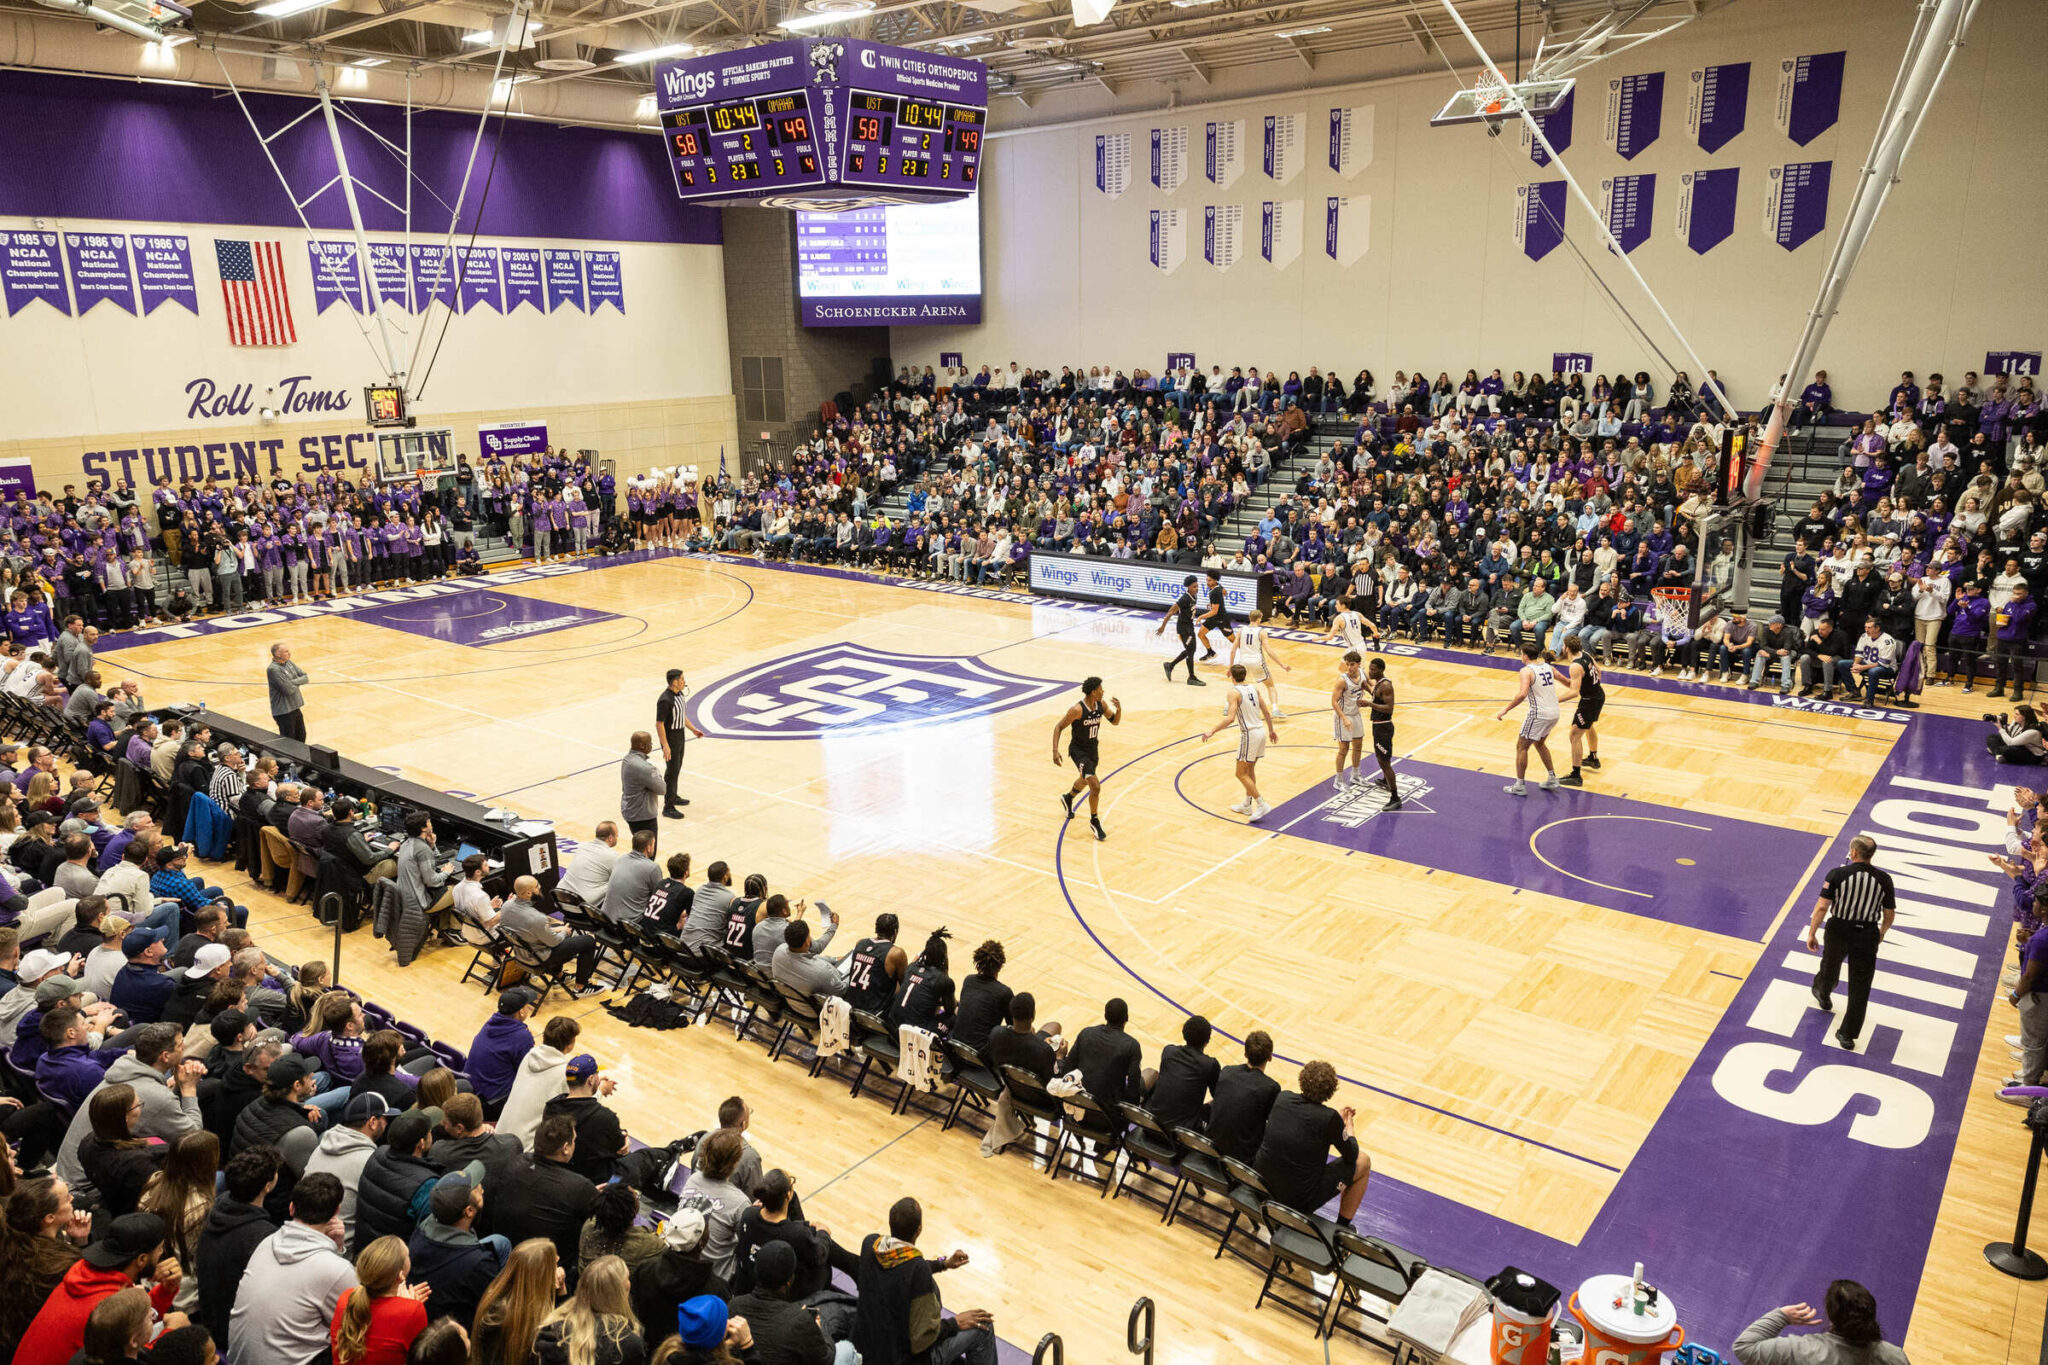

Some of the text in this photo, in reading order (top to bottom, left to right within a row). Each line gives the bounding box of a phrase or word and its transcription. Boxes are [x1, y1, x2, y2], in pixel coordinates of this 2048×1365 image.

[722, 65, 744, 76] OFFICIAL
[769, 56, 794, 70] PARTNER
[880, 55, 977, 82] TWIN CITIES ORTHOPEDICS
[664, 67, 715, 98] Wings
[723, 77, 730, 86] OF
[751, 71, 770, 82] SPORTS
[913, 77, 925, 86] Sports
[944, 82, 961, 91] Provider
[668, 93, 696, 103] Credit Union
[768, 97, 794, 113] OMAHA
[866, 97, 882, 110] UST
[676, 112, 690, 126] UST
[715, 106, 756, 129] 10:44
[906, 104, 941, 127] 10:44
[954, 109, 976, 122] OMAHA
[784, 118, 808, 140] 49
[823, 90, 838, 181] TOMMIES
[859, 118, 878, 140] 58
[676, 134, 697, 155] 58
[744, 134, 750, 150] 2
[922, 134, 930, 149] 2
[962, 132, 978, 150] 49
[776, 160, 783, 175] 3
[805, 158, 814, 170] 4
[855, 157, 862, 170] 4
[880, 158, 886, 173] 3
[903, 160, 916, 175] 23
[943, 164, 949, 178] 3
[685, 172, 693, 184] 4
[709, 168, 716, 182] 3
[732, 164, 747, 180] 23
[967, 167, 974, 179] 4
[12, 233, 40, 246] 1985
[83, 236, 109, 248] 1986
[148, 238, 173, 249] 1986
[9, 248, 48, 258] NCAA
[80, 250, 116, 260] NCAA
[146, 252, 180, 261] NCAA
[423, 248, 440, 256] 2001
[6, 270, 59, 278] Champions
[77, 271, 126, 279] Champions
[143, 272, 189, 280] Champions
[1176, 358, 1191, 369] 112
[1565, 359, 1586, 372] 113
[2002, 358, 2031, 375] 114
[185, 376, 352, 418] Roll Toms
[82, 439, 285, 491] STUDENT
[1041, 564, 1079, 586] Wings
[1091, 570, 1132, 592] Wings
[1145, 576, 1187, 598] Wings
[134, 564, 589, 639] TOMMIES
[1098, 606, 1152, 619] OF
[1246, 633, 1253, 645] 11
[1863, 645, 1879, 663] 98
[1539, 672, 1553, 686] 32
[1248, 693, 1256, 707] 4
[1772, 695, 1913, 722] Wings
[1089, 726, 1098, 739] 10
[644, 895, 667, 920] 32
[726, 921, 746, 947] 22
[850, 961, 872, 990] 24
[901, 983, 915, 1007] 1
[1502, 1325, 1522, 1346] G
